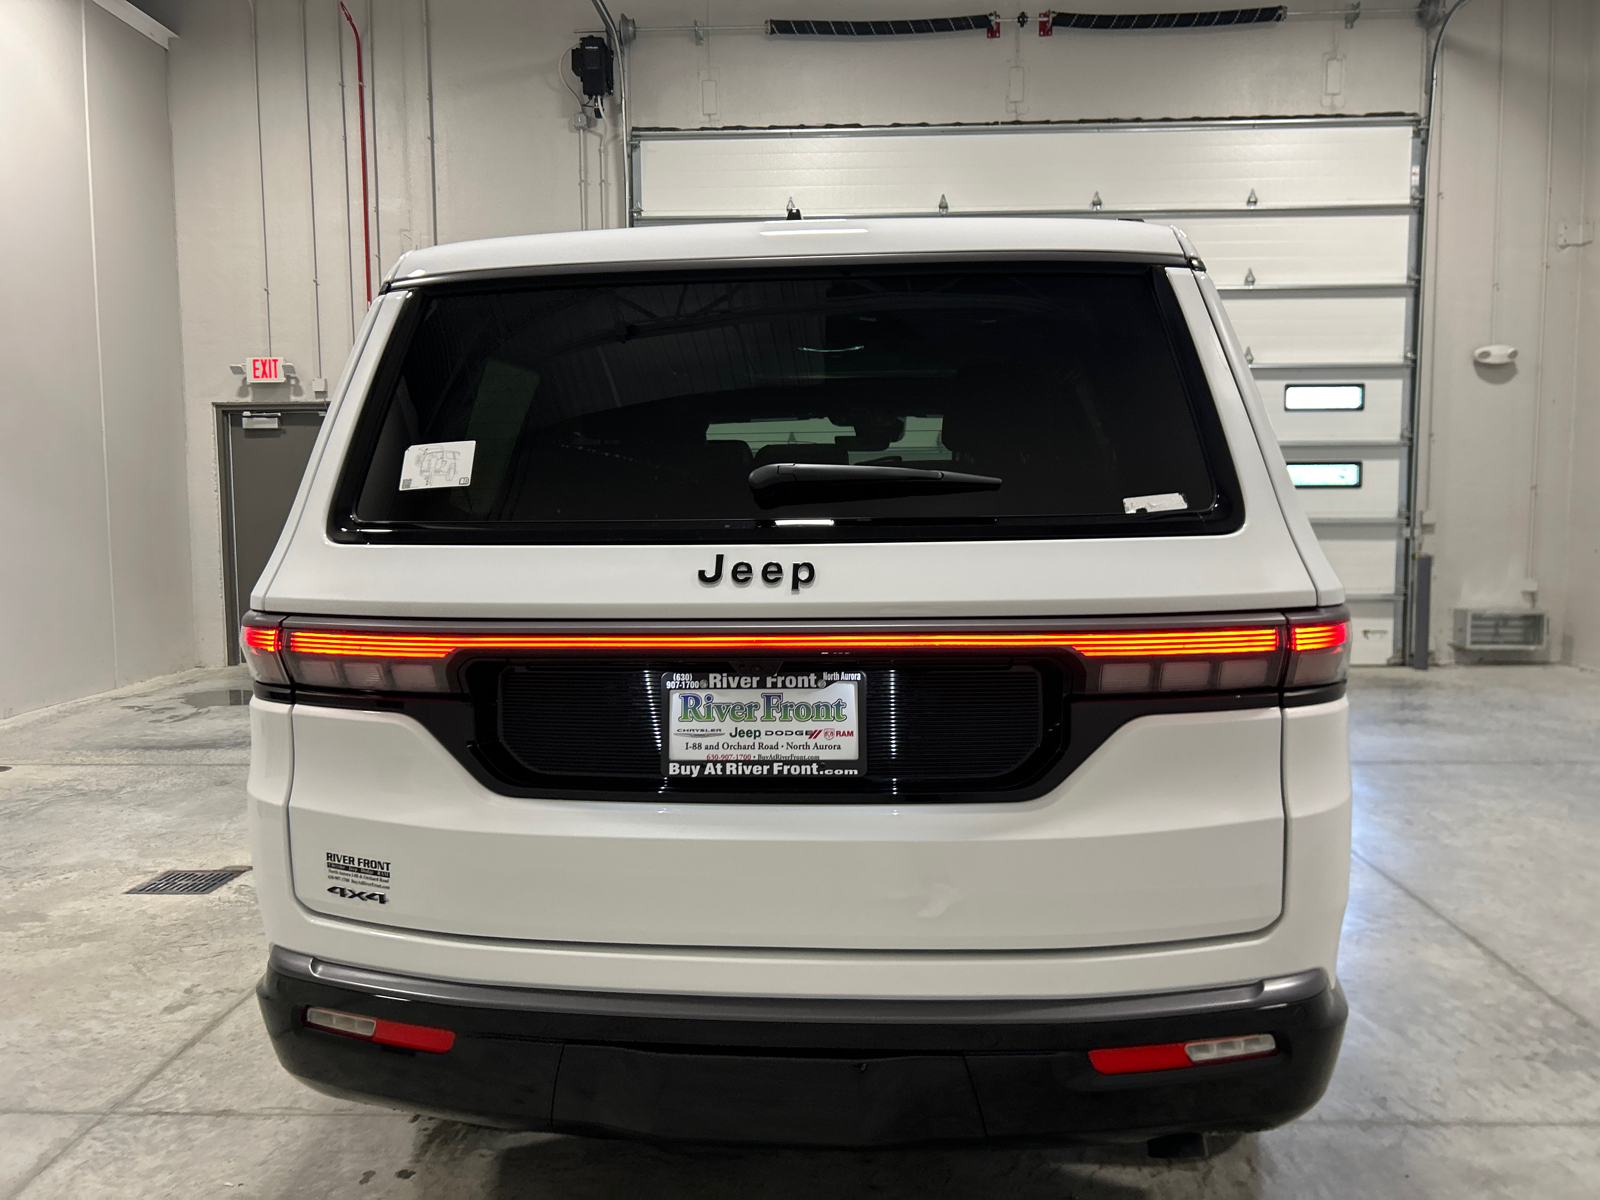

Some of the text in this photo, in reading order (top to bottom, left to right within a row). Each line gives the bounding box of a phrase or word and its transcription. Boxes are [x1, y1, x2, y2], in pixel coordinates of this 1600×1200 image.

[252, 359, 279, 379] EXIT
[698, 554, 815, 592] Jeep
[673, 673, 693, 681] (630)
[708, 673, 760, 688] River
[823, 671, 861, 680] North Aurora
[666, 681, 699, 689] 907-1700
[678, 693, 847, 722] River Front
[729, 727, 762, 739] Jeep
[685, 742, 841, 750] I-88 and Orchard Road North Aurora
[668, 762, 858, 778] Buy At River Front.com
[326, 852, 391, 871] RIVER FRONT
